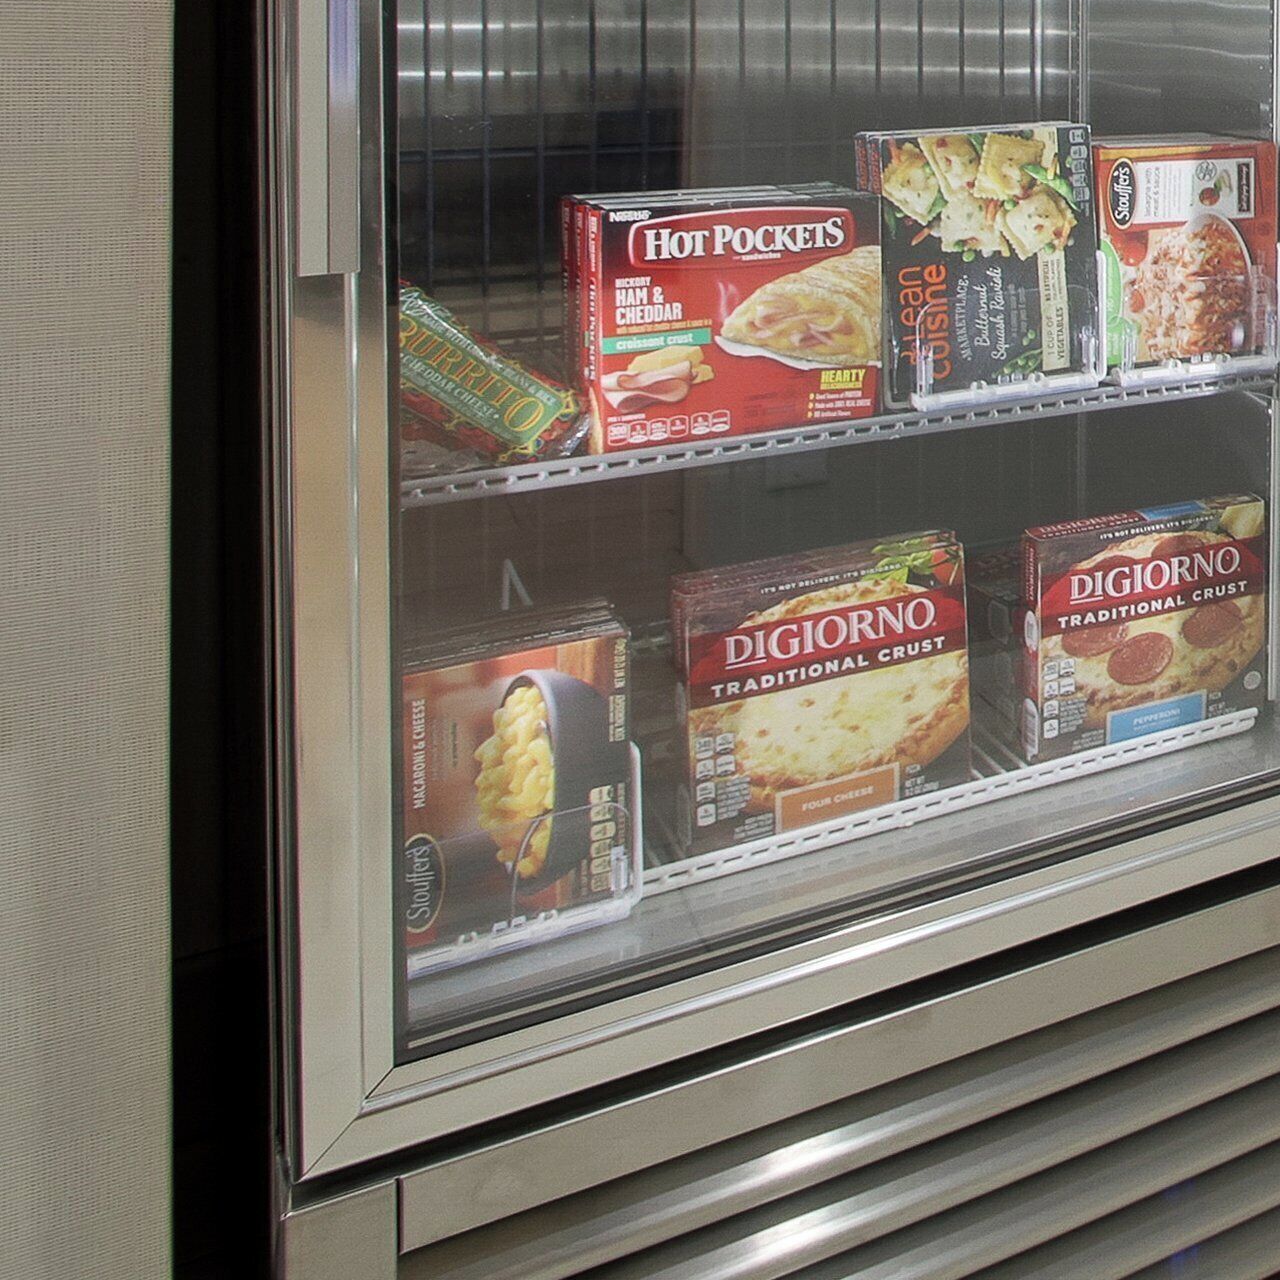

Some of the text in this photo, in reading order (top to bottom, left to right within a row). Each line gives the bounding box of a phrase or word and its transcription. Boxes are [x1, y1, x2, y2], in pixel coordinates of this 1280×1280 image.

[1113, 166, 1133, 220] Stouffer's
[644, 217, 845, 261] HOT POCKETS
[615, 276, 651, 289] HICKORY
[615, 286, 664, 307] HAM &
[987, 266, 1005, 310] Ravioli
[615, 303, 683, 325] CHEDDAR
[973, 283, 990, 346] Butternut
[1047, 315, 1054, 327] OF
[1056, 307, 1065, 360] VEGETABLES
[616, 333, 694, 351] croissant crust
[990, 313, 1010, 360] Squash
[1047, 330, 1055, 349] CUP
[402, 355, 495, 416] CHEDDAR CHEESE
[820, 369, 866, 383] HEARTY
[1114, 529, 1129, 538] NOT
[778, 582, 797, 593] NOT
[1058, 580, 1248, 629] TRADITIONAL CRUST
[711, 636, 946, 699] TRADITIONAL CRUST
[412, 698, 426, 808] MACARONI & CHEESE
[802, 786, 874, 811] FOUR CHEESE
[406, 846, 434, 920] Stouffer's
